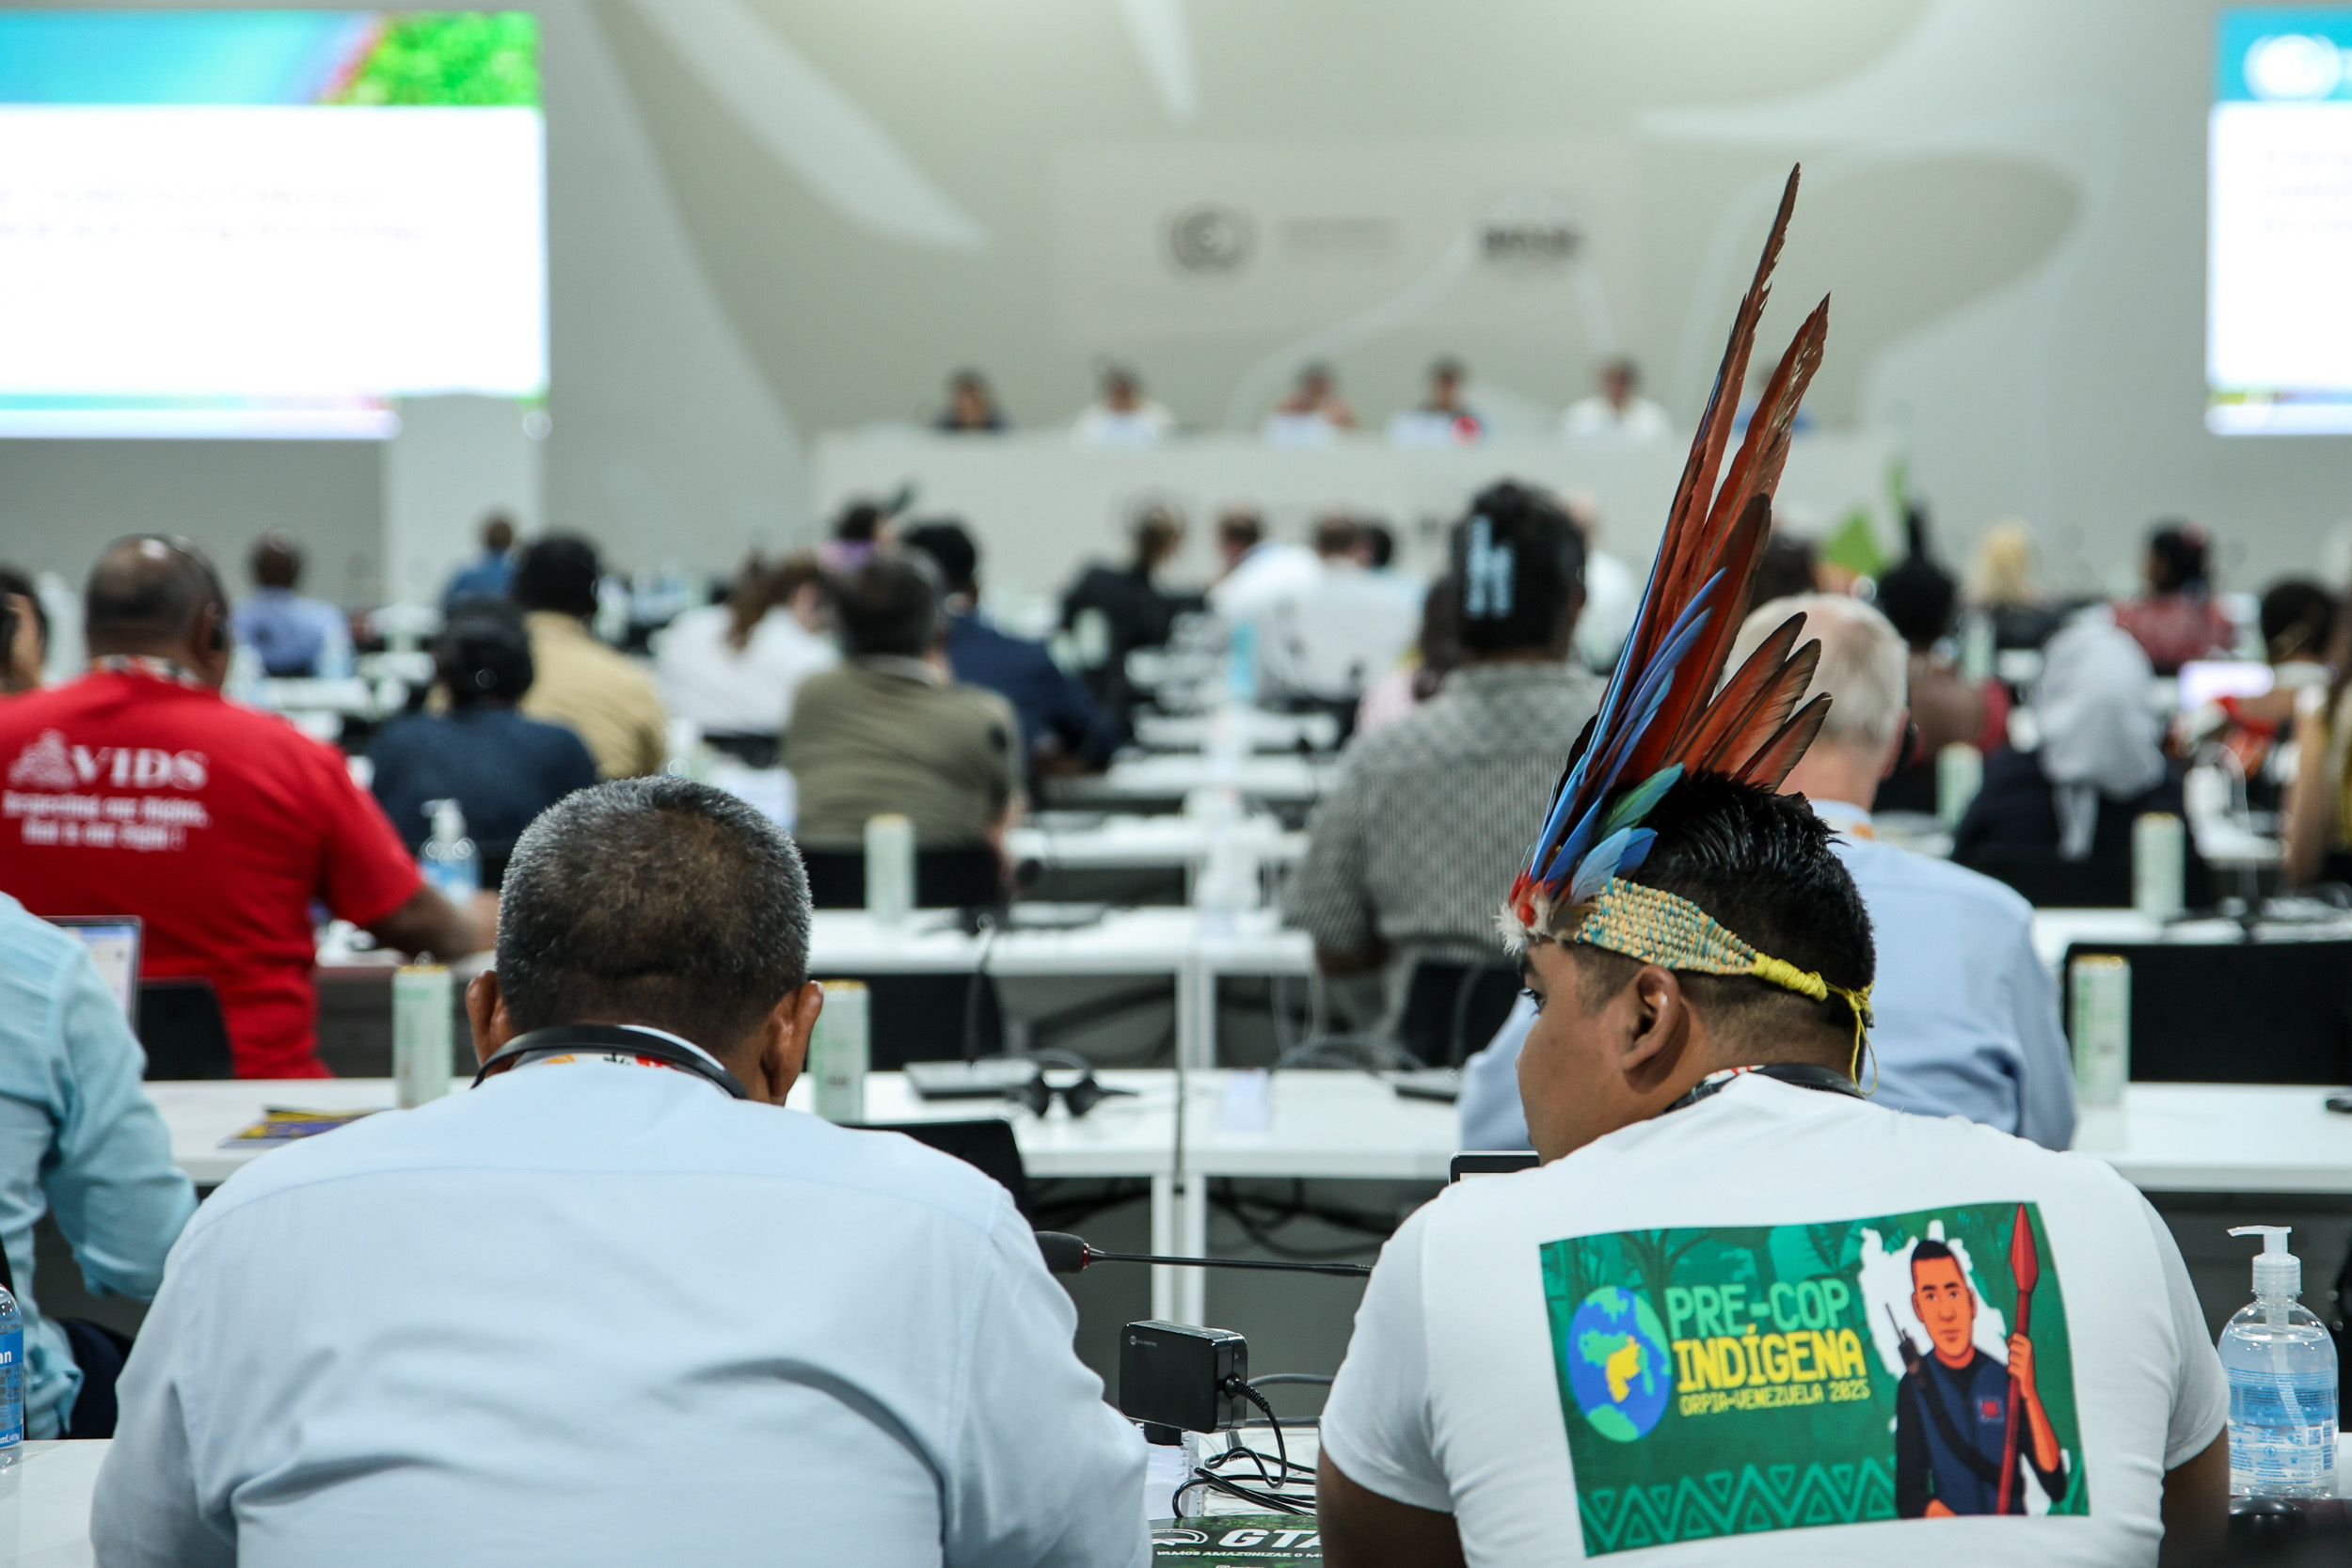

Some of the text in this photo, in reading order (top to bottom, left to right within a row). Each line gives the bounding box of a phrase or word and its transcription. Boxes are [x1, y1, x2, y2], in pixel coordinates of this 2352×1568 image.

[72, 745, 209, 790] VIDS
[1665, 1278, 1850, 1340] PRE-COP
[1672, 1323, 1867, 1393] INDÍGENA
[1678, 1377, 1870, 1417] ORPIA-VENEZUELA 2025
